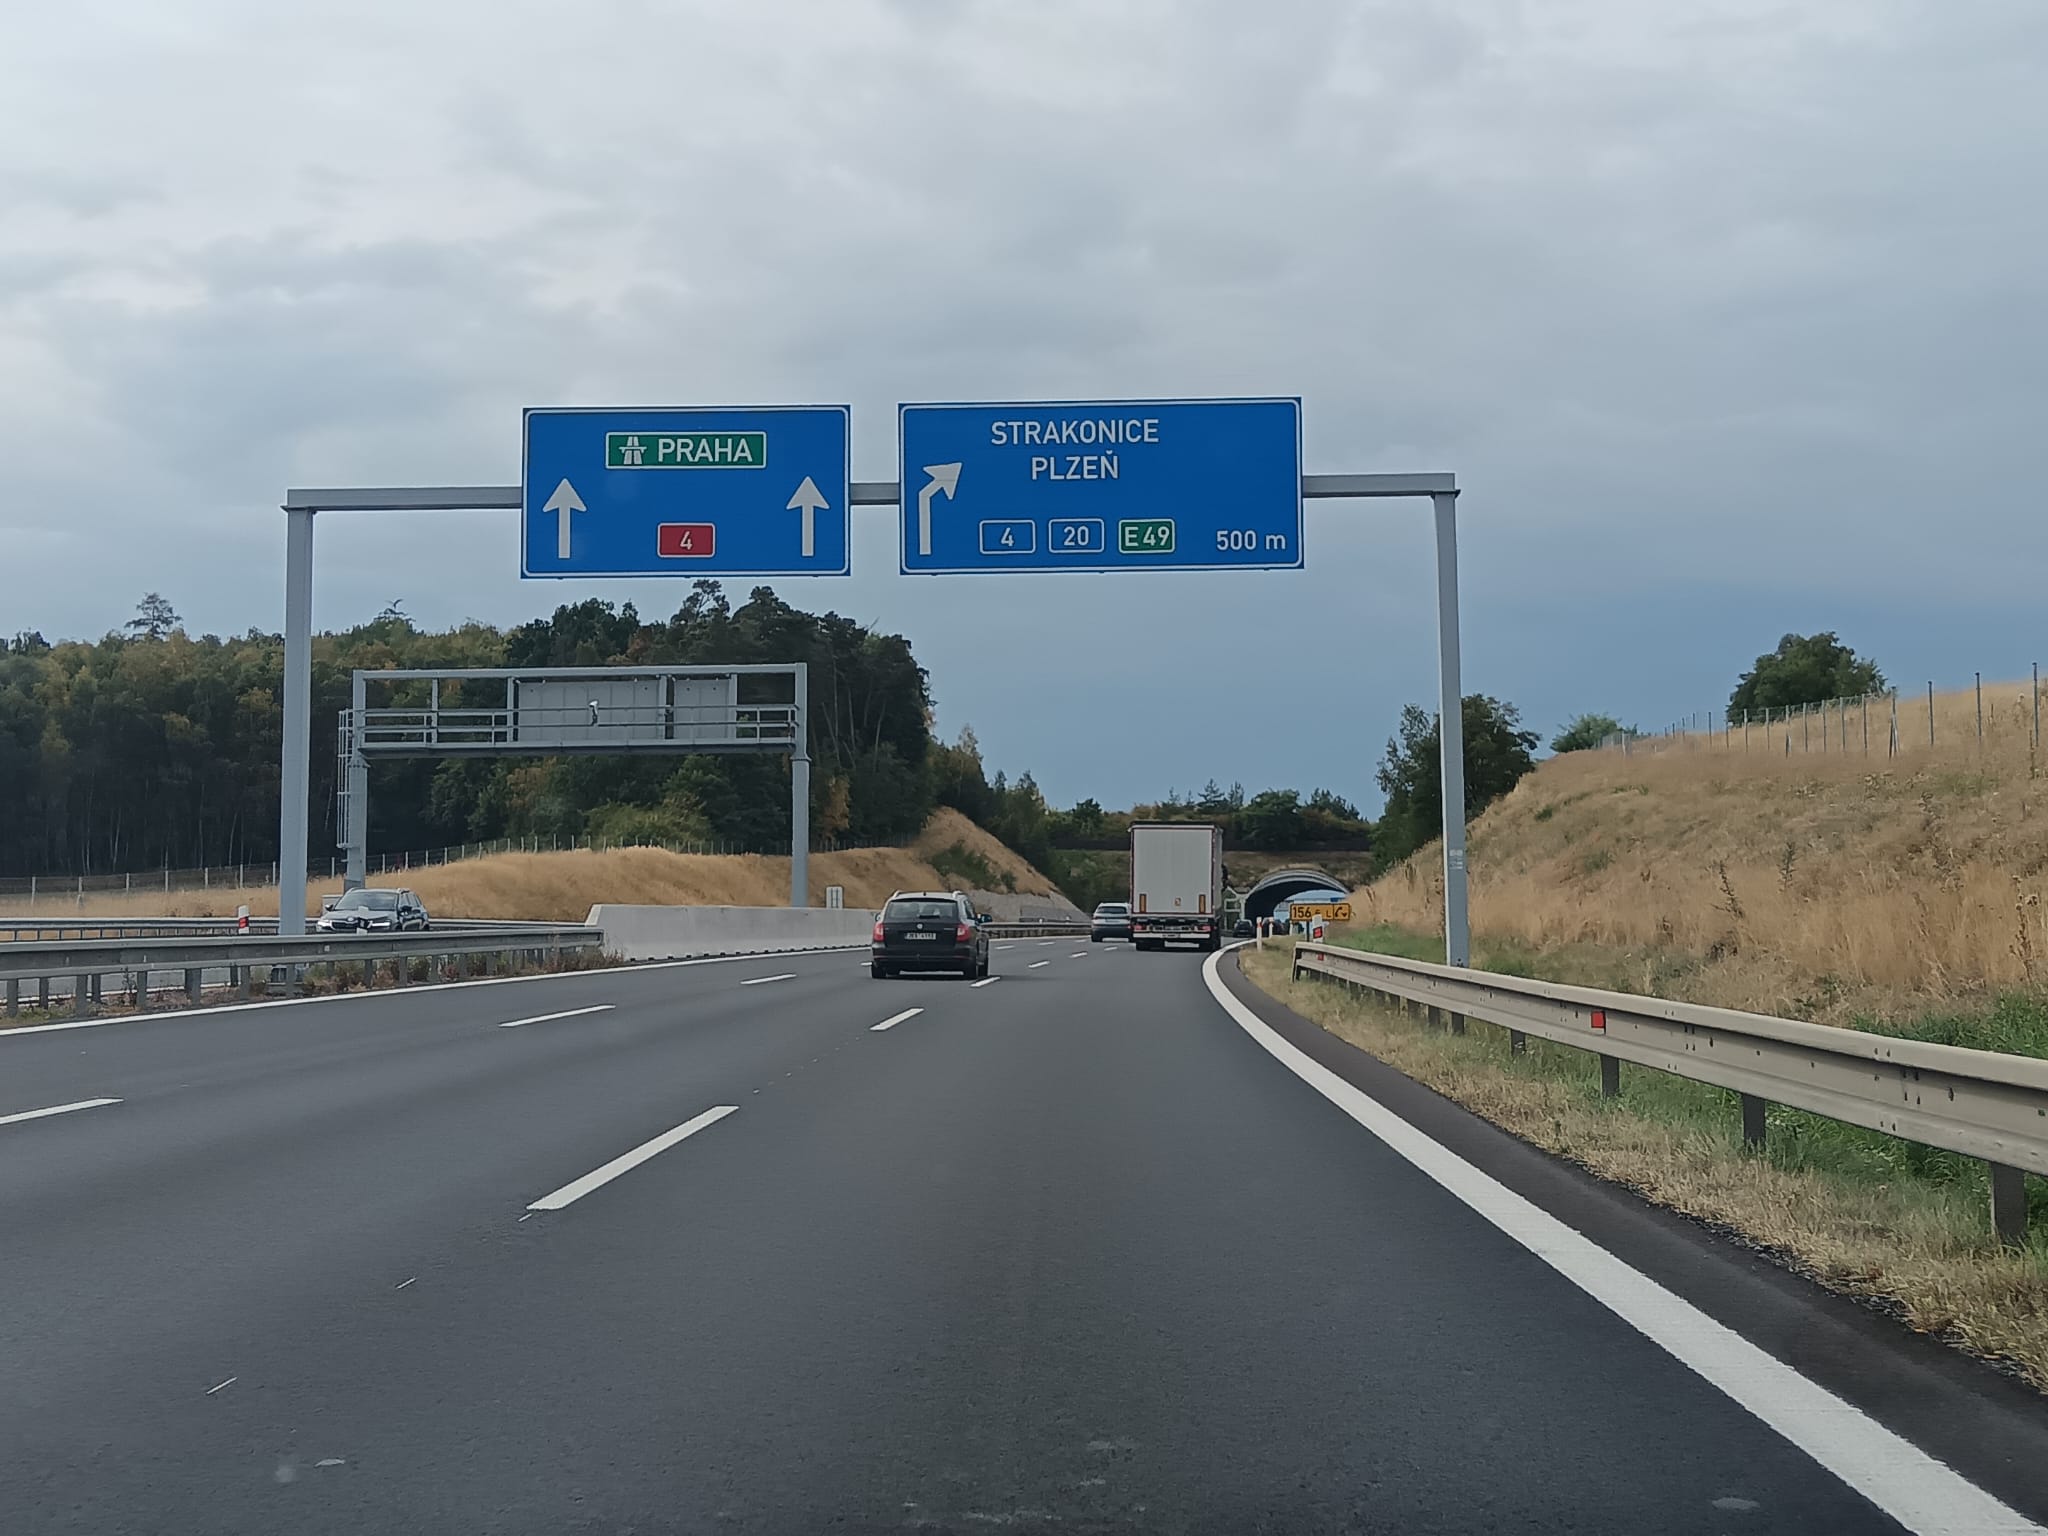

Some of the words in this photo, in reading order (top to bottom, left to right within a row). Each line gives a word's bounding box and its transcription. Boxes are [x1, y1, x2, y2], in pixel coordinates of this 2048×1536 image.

[991, 418, 1159, 445] STRAKONICE
[658, 438, 753, 463] PRAHA
[1031, 449, 1118, 480] PLZEŇ
[679, 530, 693, 550] 4
[1000, 527, 1015, 547] 4
[1063, 525, 1090, 546] 20
[1216, 530, 1257, 551] 500
[1265, 534, 1286, 550] m
